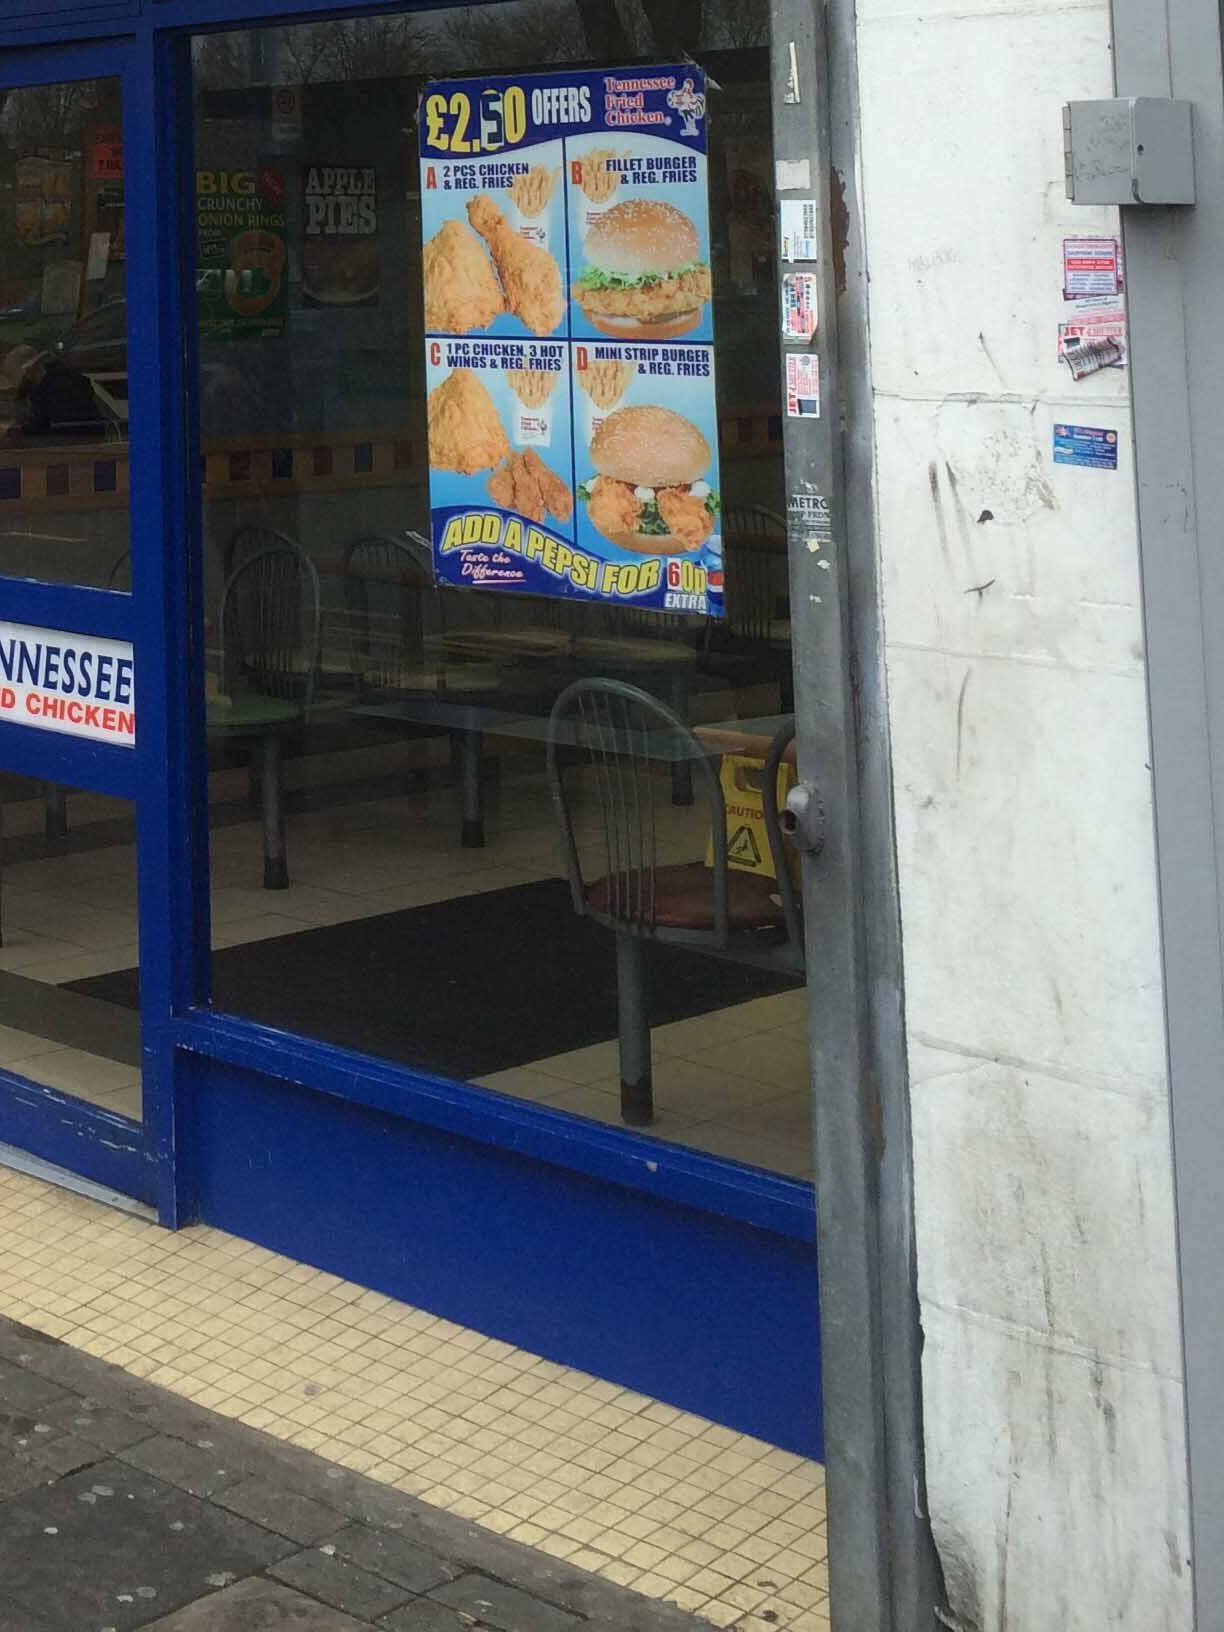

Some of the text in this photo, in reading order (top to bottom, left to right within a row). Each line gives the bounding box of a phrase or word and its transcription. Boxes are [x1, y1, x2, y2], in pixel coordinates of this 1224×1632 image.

[604, 77, 676, 93] Tennessee
[531, 86, 591, 126] OFFERS
[604, 93, 644, 109] Fried
[443, 163, 529, 178] 2 PCS CHICKEN
[606, 156, 696, 171] FILLET BURGER
[305, 167, 376, 195] APPLE
[426, 166, 436, 189] A
[571, 161, 582, 185] B
[620, 170, 697, 184] & REG. FRIES
[196, 170, 256, 194] BIG
[443, 176, 513, 191] & REG. FRIES
[197, 197, 264, 211] CRUNCHY
[198, 214, 243, 227] ONION
[305, 195, 377, 235] PIES
[430, 342, 440, 366] C
[452, 343, 470, 356] PC
[528, 345, 537, 357] 3
[539, 345, 564, 358] HOT
[576, 346, 588, 371] D
[595, 347, 709, 363] MINI STRIP BURGER
[447, 355, 561, 371] WINGS & REG. FRIES
[638, 363, 710, 377] & REG. FRIES
[441, 513, 502, 552] ADD
[503, 519, 522, 552] A
[526, 527, 599, 591] PEPSI
[601, 558, 661, 595] FOR
[460, 549, 512, 564] Taste the
[461, 563, 525, 579] Difference
[665, 592, 707, 610] EXTRA
[26, 692, 134, 735] CHICKEN
